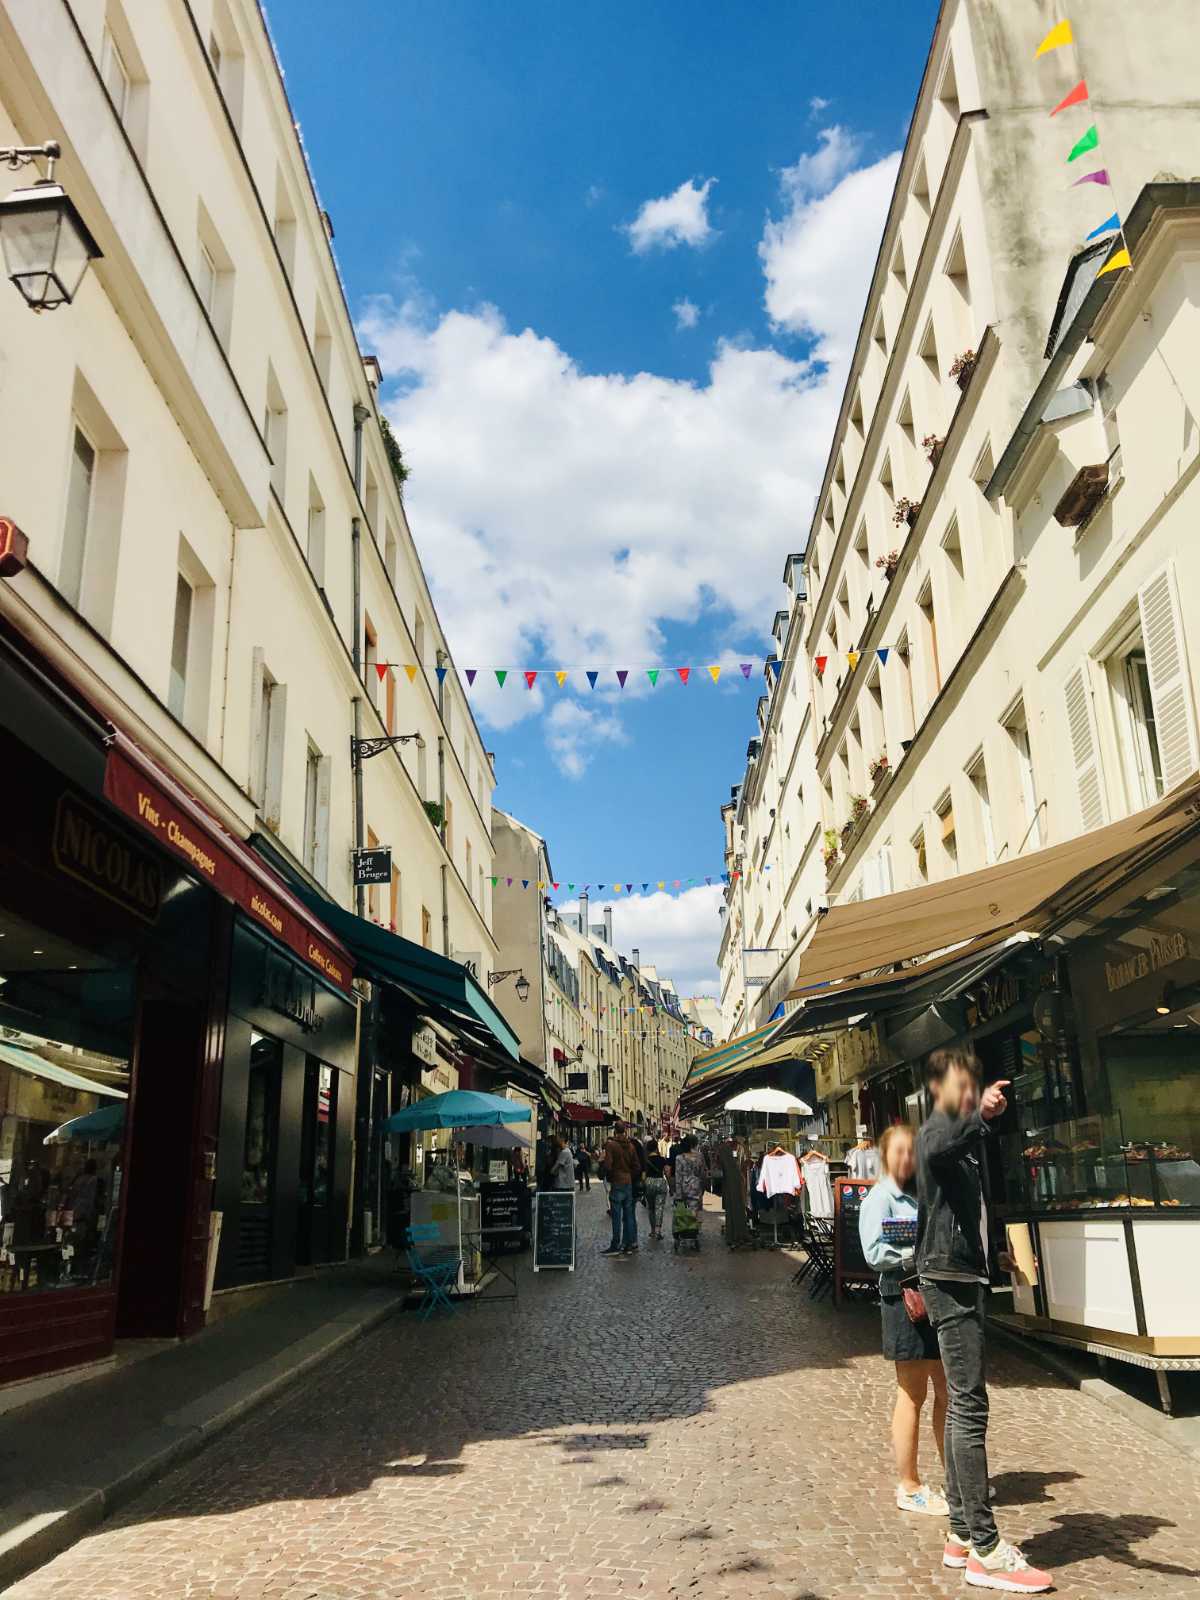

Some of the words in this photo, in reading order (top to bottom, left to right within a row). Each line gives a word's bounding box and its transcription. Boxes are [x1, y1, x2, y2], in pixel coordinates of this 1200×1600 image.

[60, 808, 157, 908] NICOLAS
[137, 792, 161, 827] Vins
[167, 820, 216, 876] Champagnes
[357, 857, 374, 868] Jeff
